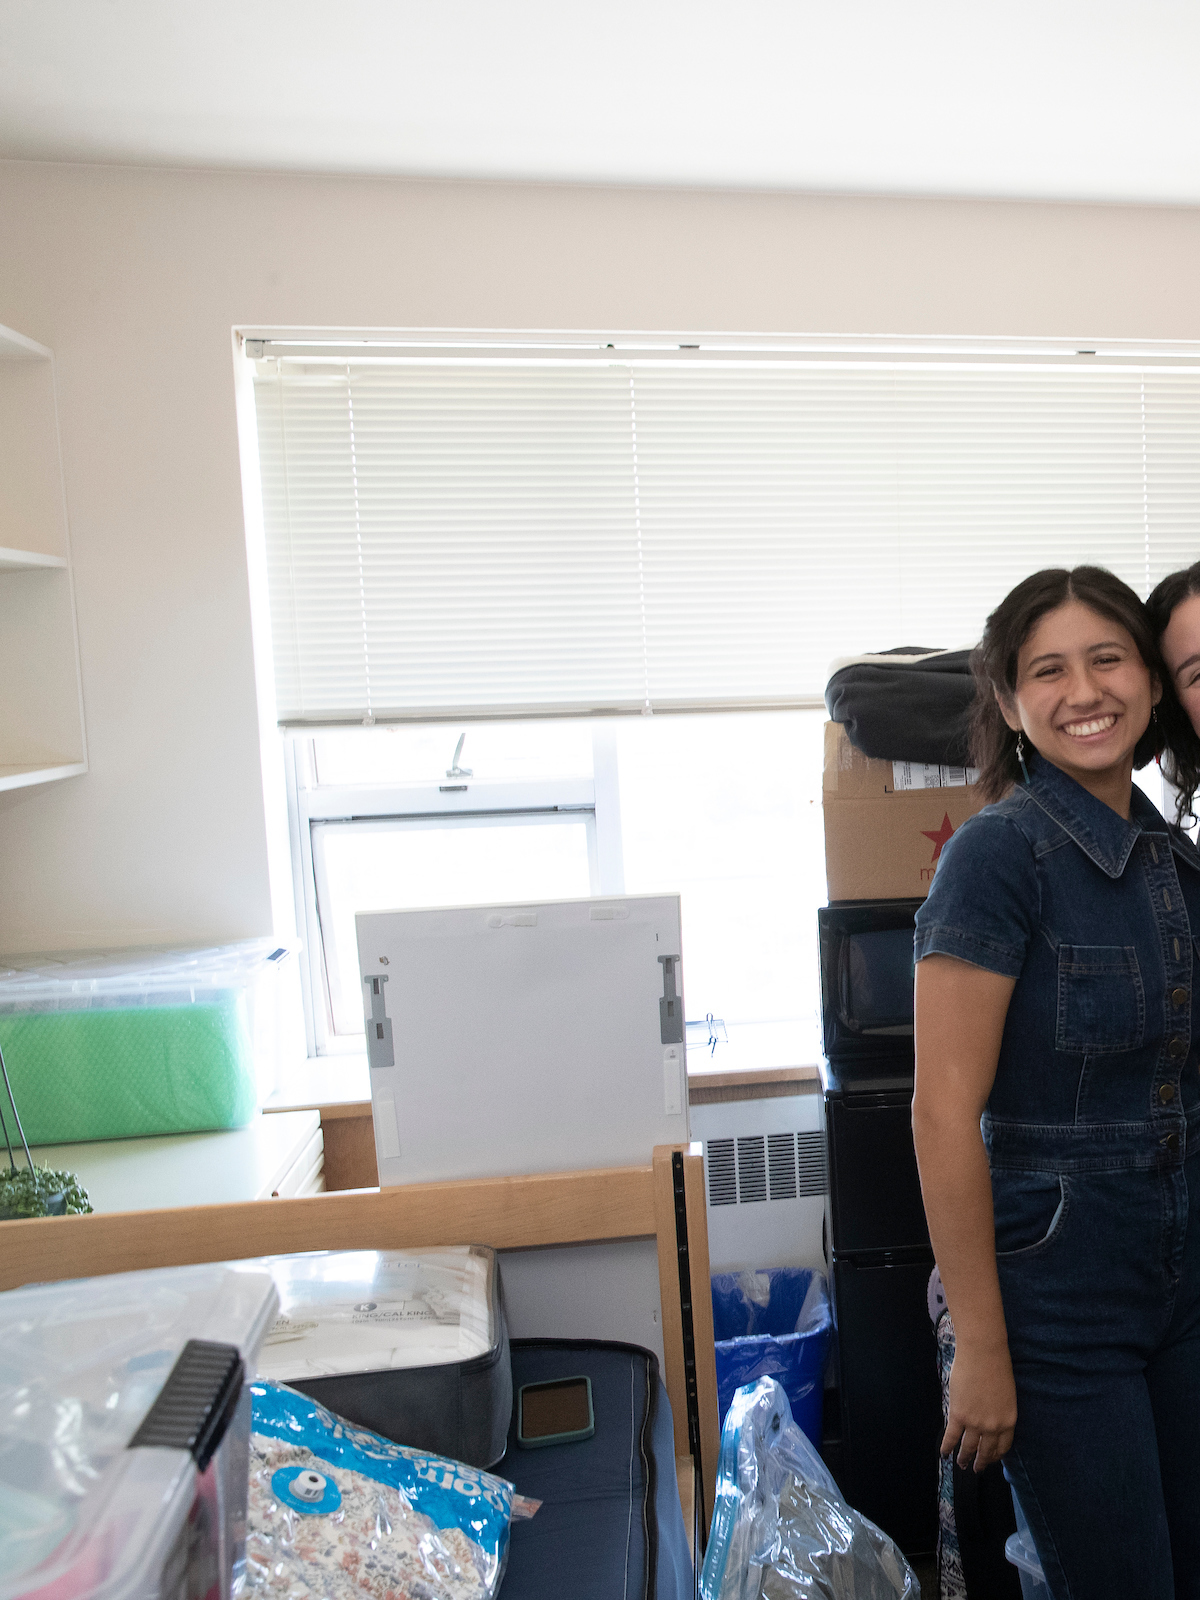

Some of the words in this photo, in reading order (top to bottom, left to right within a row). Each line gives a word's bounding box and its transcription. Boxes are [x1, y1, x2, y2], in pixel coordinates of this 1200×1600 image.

[352, 1310, 404, 1319] KING/CAL
[406, 1309, 433, 1317] KING
[413, 1458, 511, 1521] oom
